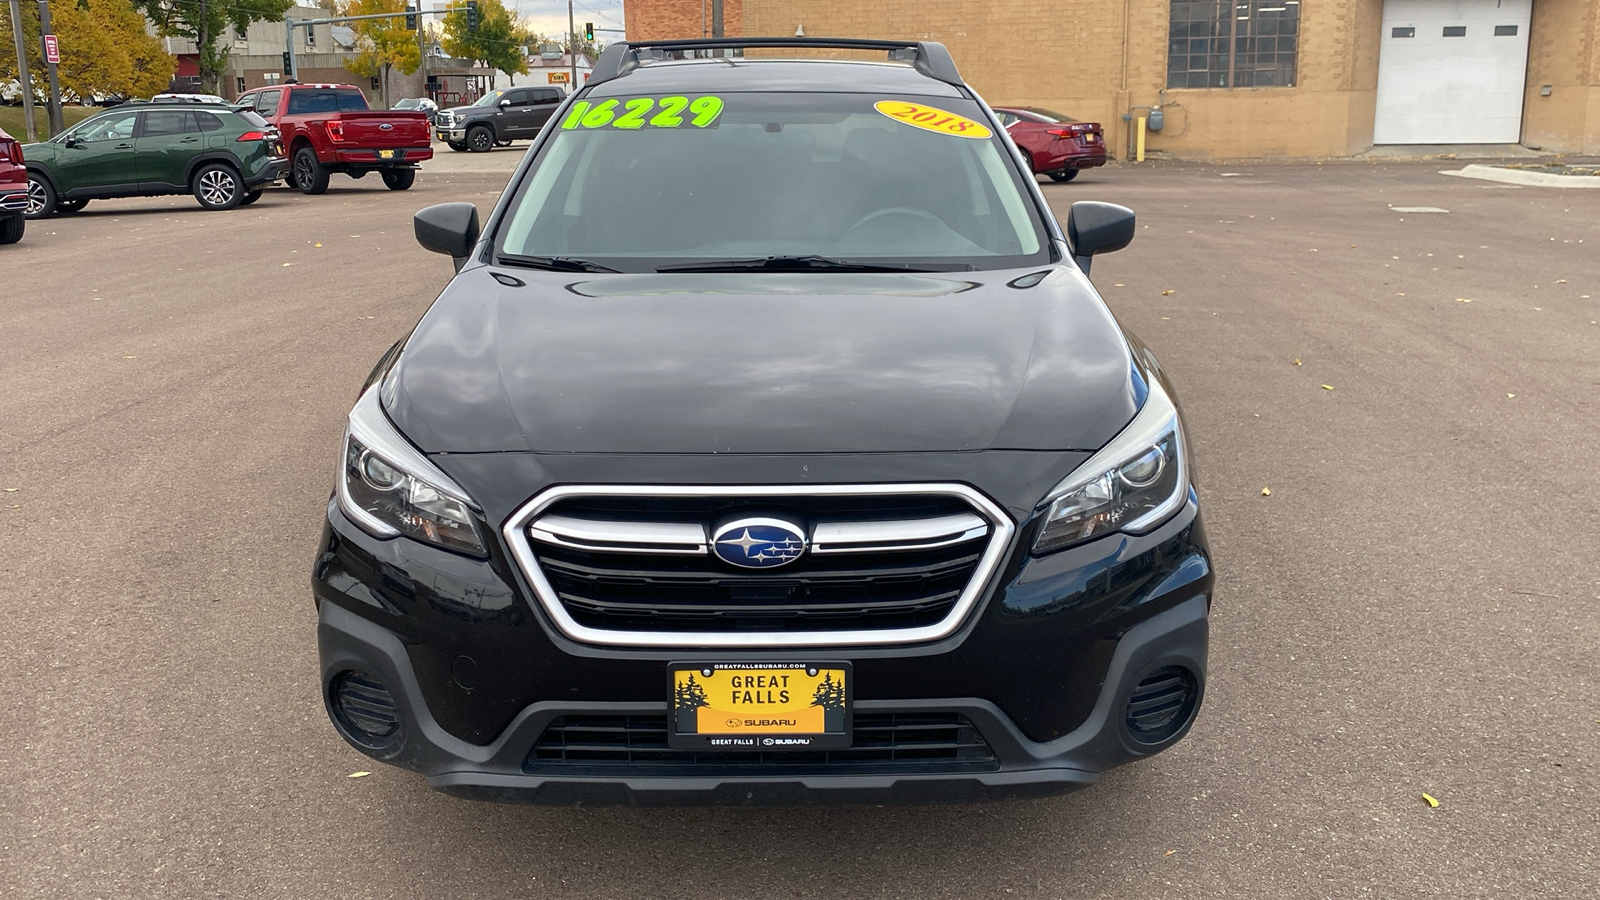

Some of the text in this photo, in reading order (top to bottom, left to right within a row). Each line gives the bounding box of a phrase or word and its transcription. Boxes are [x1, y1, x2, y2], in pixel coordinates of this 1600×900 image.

[562, 96, 724, 129] 16229
[891, 106, 975, 132] 2018
[731, 675, 789, 688] GREAT
[732, 690, 789, 704] FALLS
